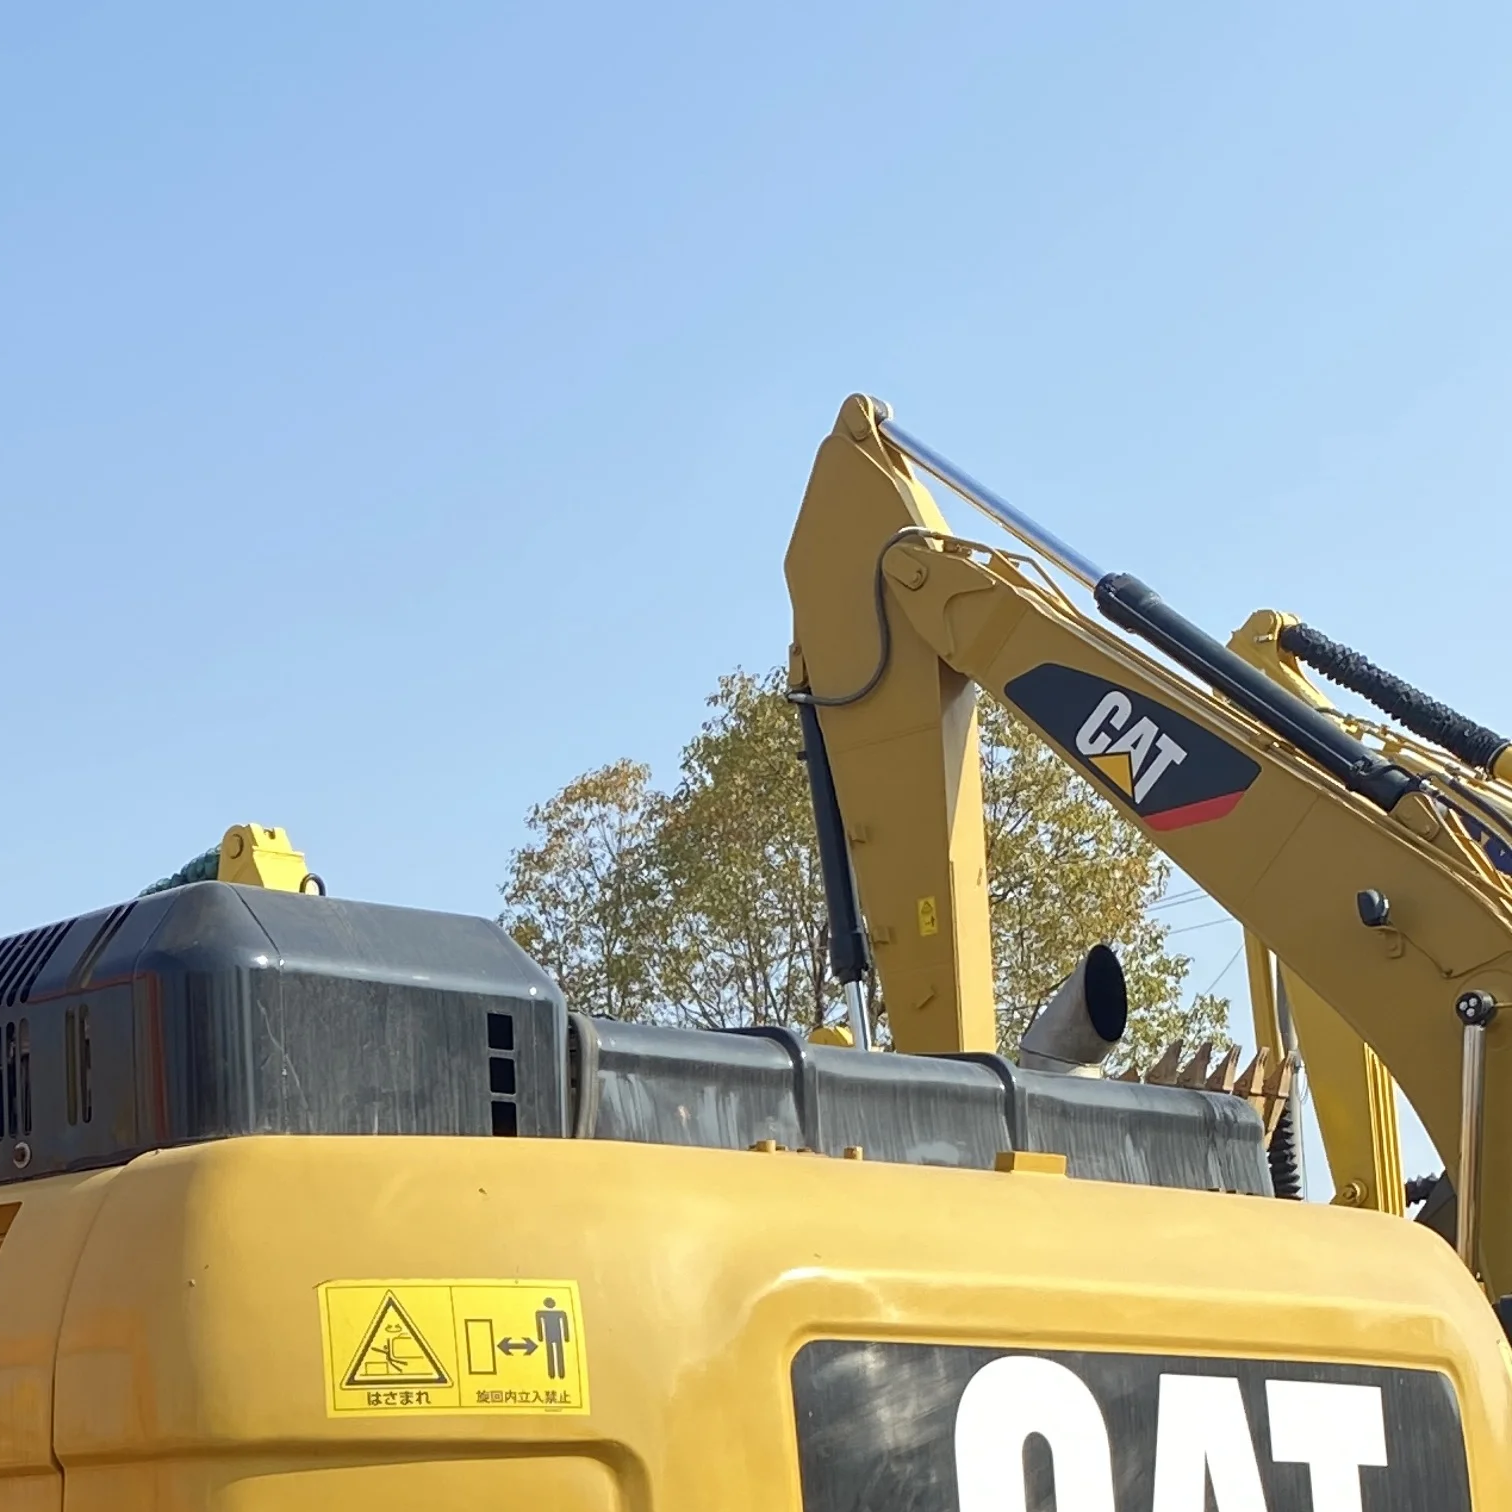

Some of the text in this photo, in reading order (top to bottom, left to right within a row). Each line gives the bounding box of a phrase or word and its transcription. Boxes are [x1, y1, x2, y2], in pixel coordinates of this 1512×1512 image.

[1075, 690, 1187, 803] CAT
[367, 1390, 431, 1406] はさまれ
[476, 1389, 572, 1404] 旋回内立入禁止
